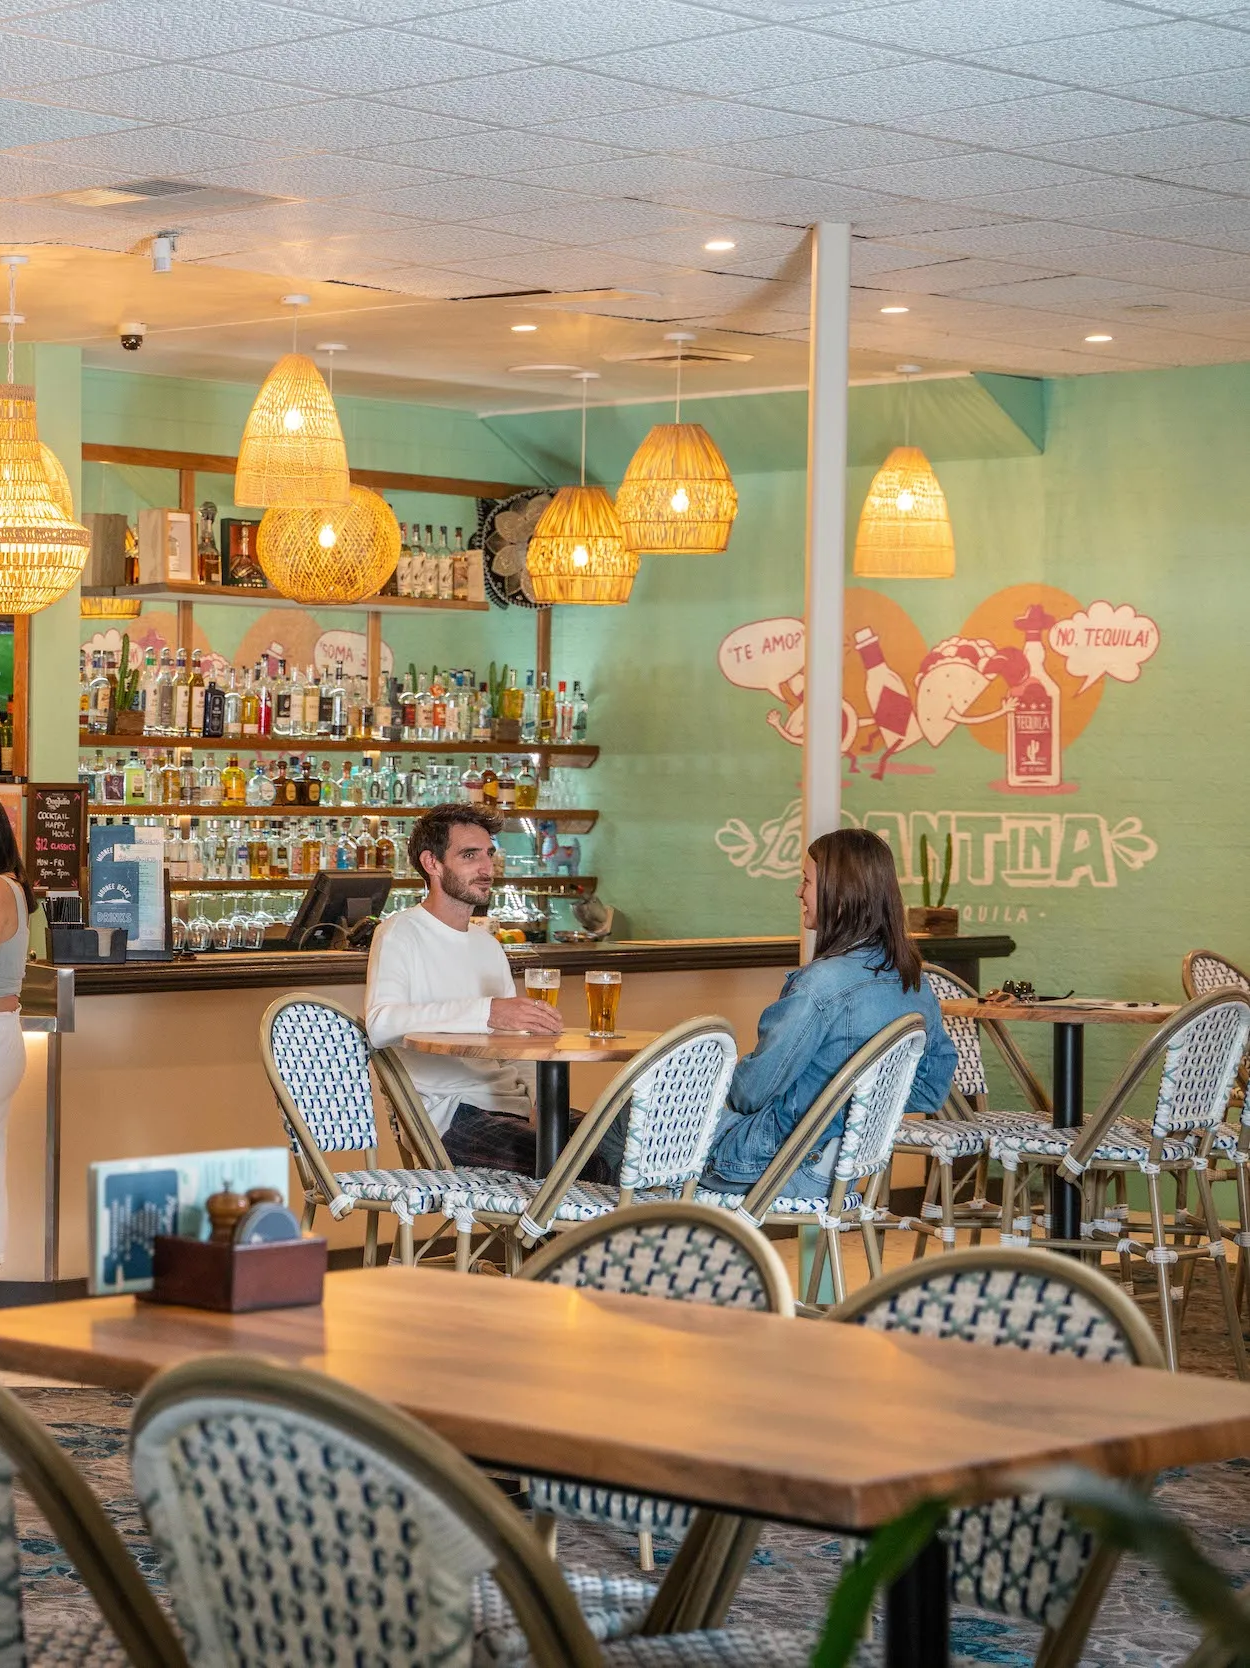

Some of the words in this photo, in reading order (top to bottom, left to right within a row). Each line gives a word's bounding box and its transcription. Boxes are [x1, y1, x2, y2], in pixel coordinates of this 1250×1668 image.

[37, 811, 70, 820] COCKTAIL
[45, 821, 66, 830] HAPPY
[35, 837, 48, 851] $12
[50, 843, 76, 851] CLASSICS
[840, 808, 1118, 888] ANTINA
[97, 883, 115, 898] MOONEE
[116, 883, 131, 899] BEACH
[96, 911, 133, 923] DRINKS
[951, 904, 1029, 923] QUILA
